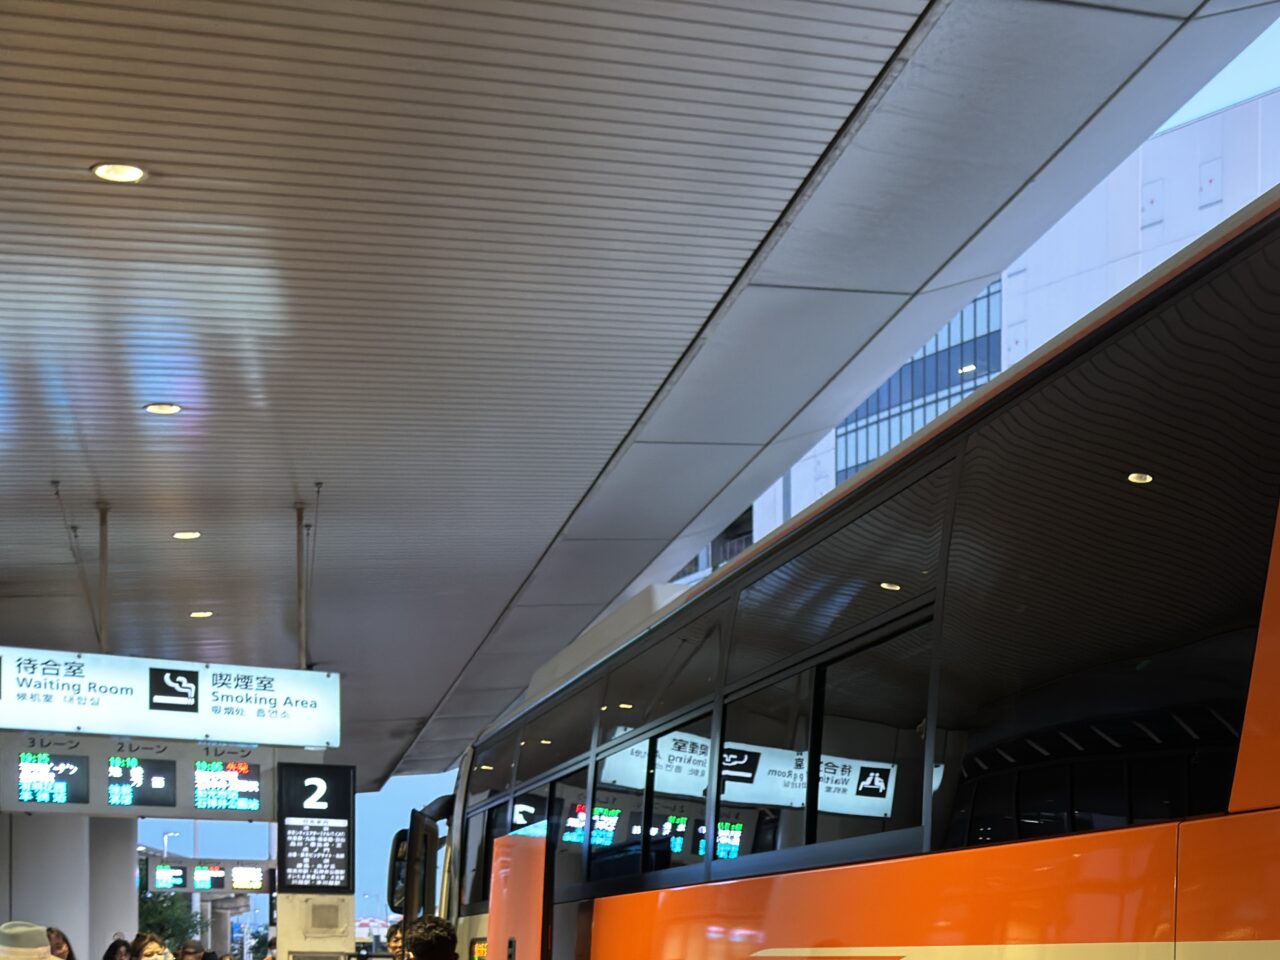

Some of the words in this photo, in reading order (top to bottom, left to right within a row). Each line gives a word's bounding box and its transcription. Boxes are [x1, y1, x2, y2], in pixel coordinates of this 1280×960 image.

[16, 657, 85, 678] 待合室
[16, 677, 81, 695] Waiting
[88, 682, 134, 696] Room
[212, 673, 275, 692] 喫煙室
[211, 691, 277, 709] Smoking
[283, 697, 318, 709] Area
[303, 776, 328, 810] 2
